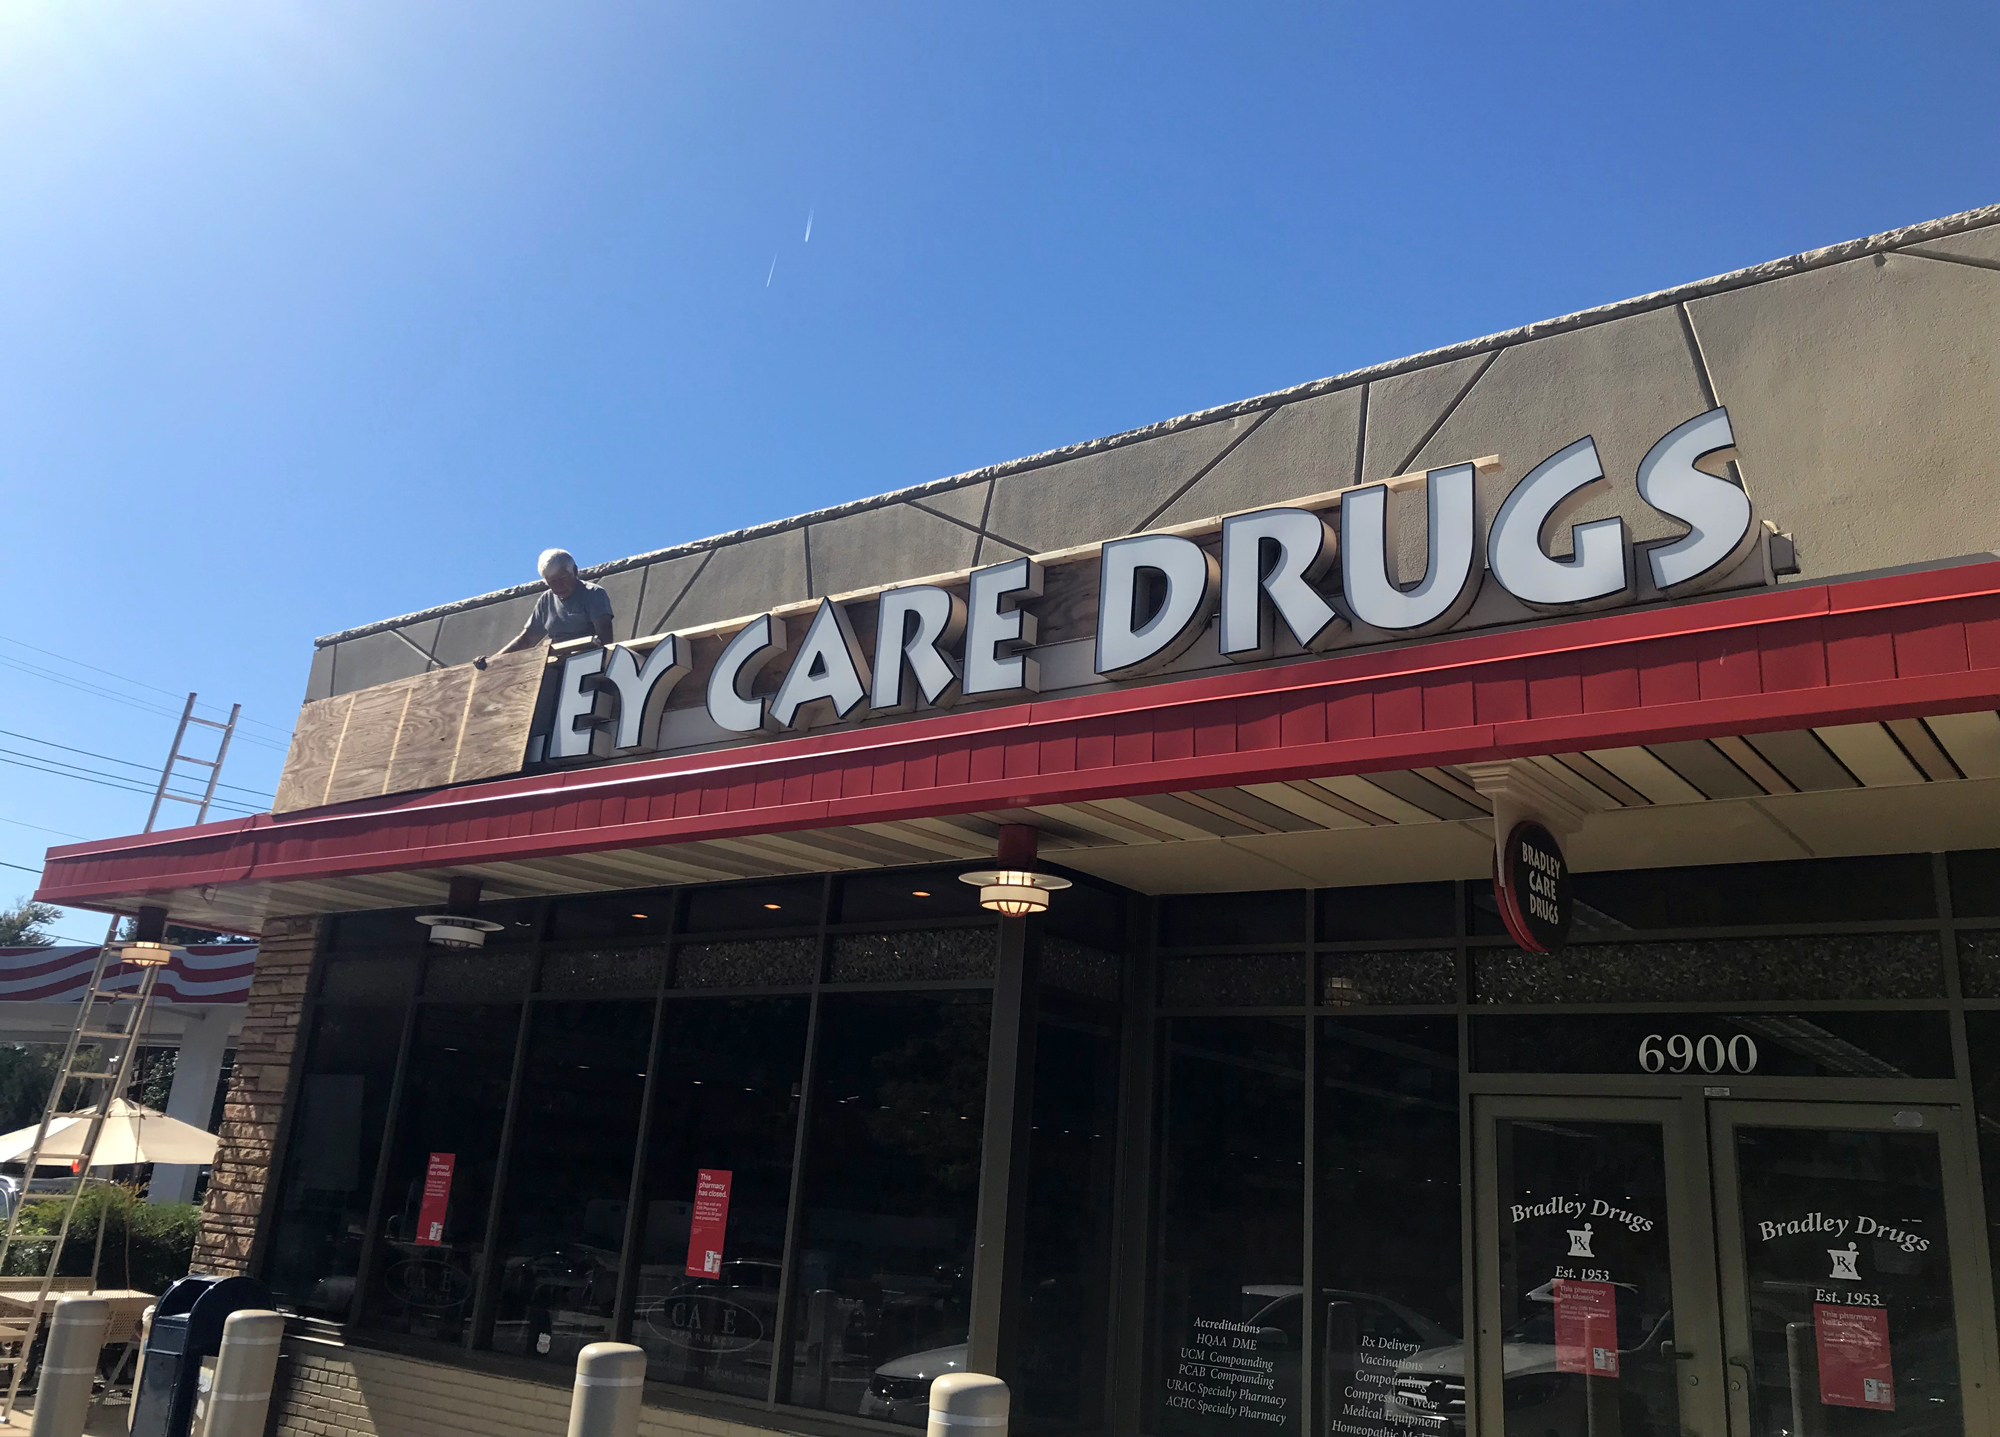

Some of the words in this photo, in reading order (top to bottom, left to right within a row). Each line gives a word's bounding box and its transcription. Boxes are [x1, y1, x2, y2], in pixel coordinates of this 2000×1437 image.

[526, 633, 678, 762] EY
[706, 557, 1030, 733] CARE
[1095, 406, 1752, 675] DRUGS
[1522, 842, 1561, 880] BRADLEY
[1529, 870, 1557, 901] CARE
[1529, 893, 1559, 925] DRUGS
[1638, 1034, 1758, 1074] 6900
[699, 1181, 726, 1191] pharmacy
[700, 1173, 711, 1181] This
[708, 1190, 727, 1198] closed.
[1510, 1196, 1586, 1224] Bradley
[1591, 1199, 1654, 1233] Drugs
[1758, 1212, 1849, 1242] Bradley
[1855, 1215, 1930, 1254] Drugs
[1555, 1266, 1576, 1280] Est.
[1581, 1267, 1610, 1281] 1953
[1560, 1285, 1573, 1293] This
[1574, 1287, 1606, 1297] pharmacy
[1816, 1288, 1841, 1304] Est.
[1846, 1291, 1880, 1307] 1953
[1193, 1316, 1261, 1334] Accreditations
[1822, 1310, 1837, 1318] This
[1840, 1312, 1877, 1323] pharmacy
[671, 1329, 734, 1346] PHARMACY
[1196, 1333, 1227, 1347] HQAA
[1232, 1337, 1258, 1351] DME
[1361, 1335, 1375, 1347] Rx
[1378, 1337, 1421, 1356] Delivery
[1180, 1347, 1205, 1360] UCM
[1209, 1351, 1274, 1372] Compounding
[1359, 1352, 1423, 1371] Vaccinations
[1178, 1363, 1206, 1377] PCAB
[1210, 1368, 1275, 1390] Compounding
[1355, 1369, 1428, 1394] Compounding
[1166, 1378, 1197, 1393] URAC
[1197, 1383, 1237, 1401] Specialty
[1239, 1388, 1287, 1409] Pharmacy
[1344, 1385, 1408, 1406] Compression
[1412, 1396, 1440, 1410] Wear
[1165, 1395, 1197, 1410] ACHC
[1197, 1399, 1237, 1419] Specialty
[1239, 1405, 1287, 1426] Pharmacy
[1342, 1403, 1382, 1420] Medical
[1384, 1410, 1442, 1429] Equipment
[1331, 1419, 1398, 1437] Homeopathic
